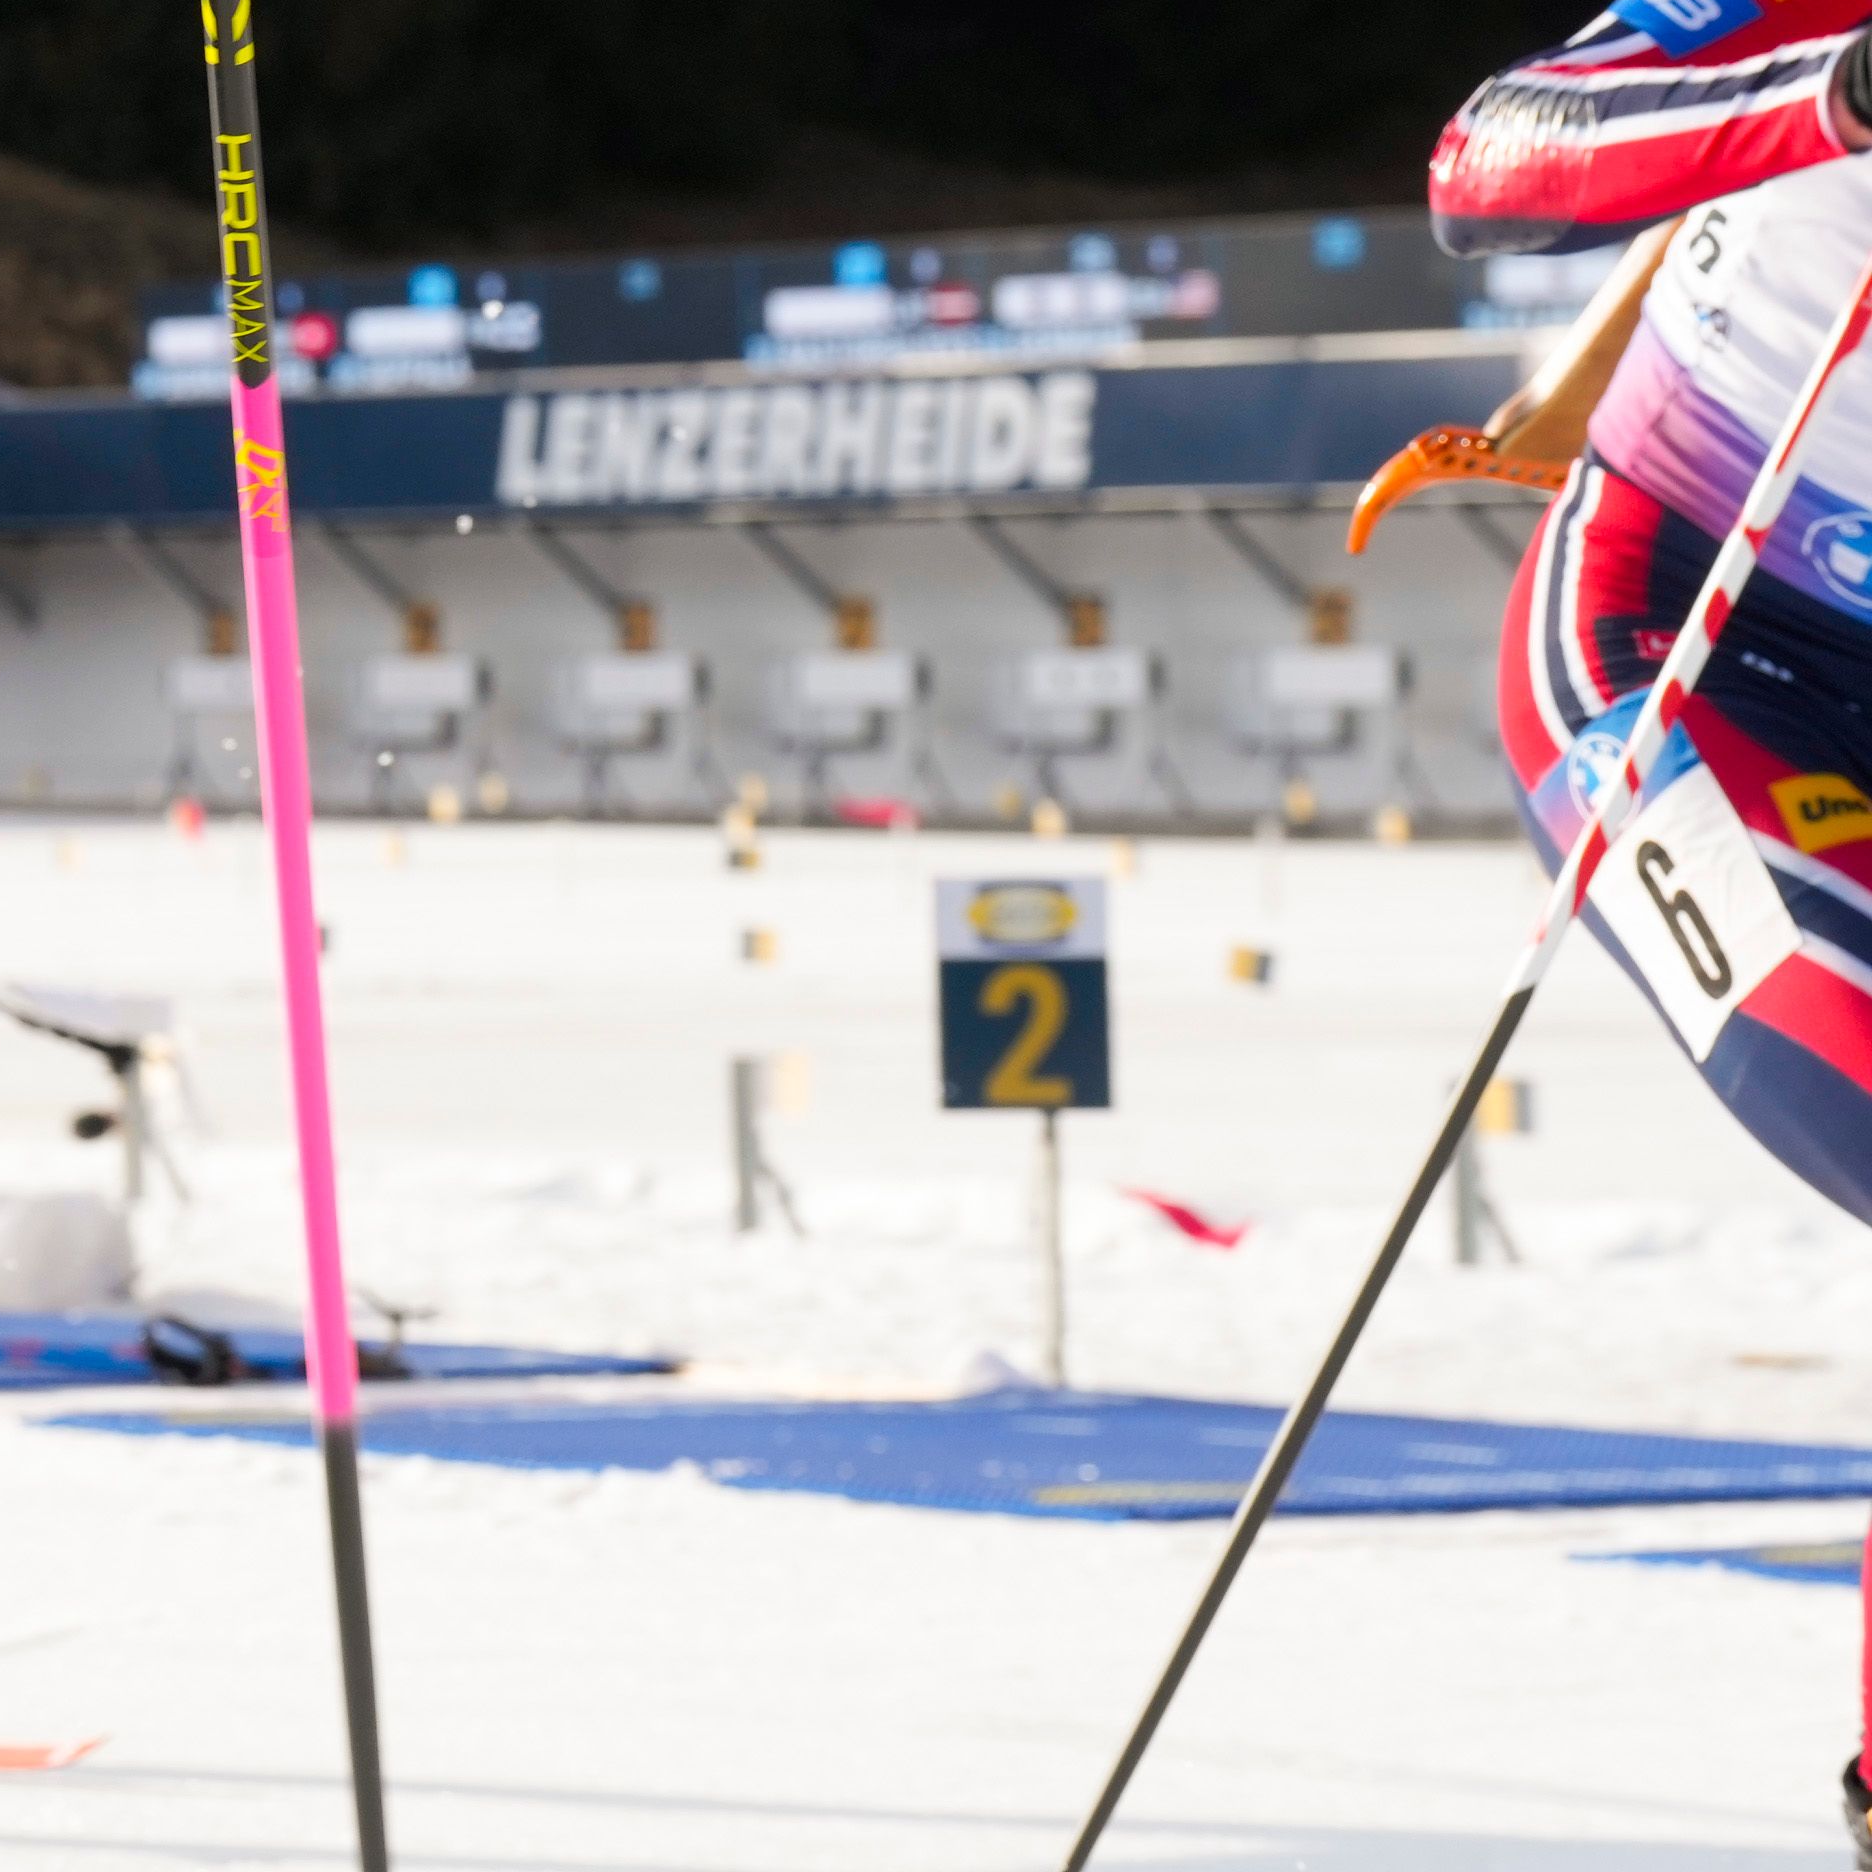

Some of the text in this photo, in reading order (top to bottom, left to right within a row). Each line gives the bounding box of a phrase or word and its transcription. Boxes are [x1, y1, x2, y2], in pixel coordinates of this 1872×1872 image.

[493, 372, 1097, 505] LENZERHEIDE
[1636, 840, 1733, 1001] 6
[978, 965, 1069, 1103] 2
